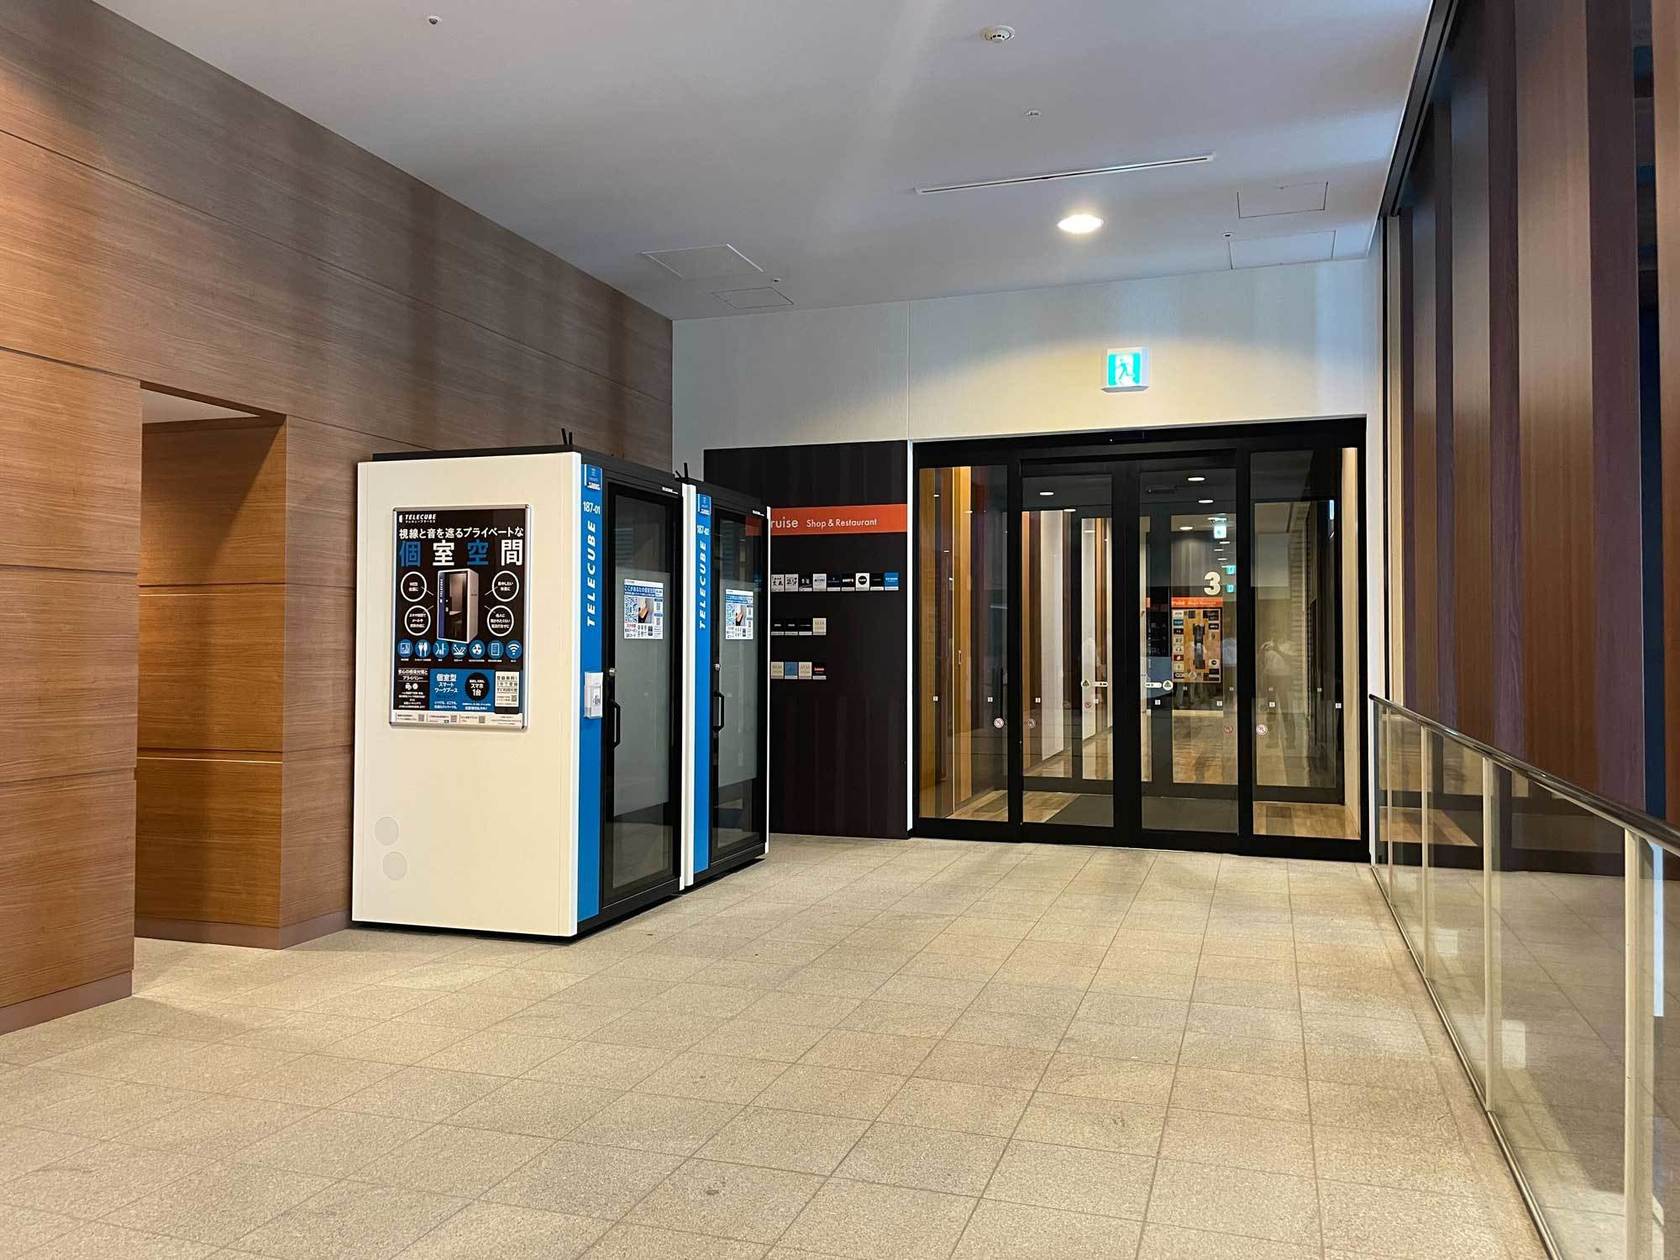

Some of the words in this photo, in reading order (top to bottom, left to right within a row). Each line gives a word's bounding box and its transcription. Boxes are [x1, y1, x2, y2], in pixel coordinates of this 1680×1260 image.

[583, 501, 601, 515] 187-01
[399, 526, 524, 539] 視線と音を遮るプライベートな
[806, 519, 826, 531] Shop
[828, 519, 834, 527] &
[836, 518, 878, 526] Restaurant
[400, 539, 523, 567] 個室空間
[587, 520, 596, 627] TELECUBE
[1204, 571, 1221, 596] 3
